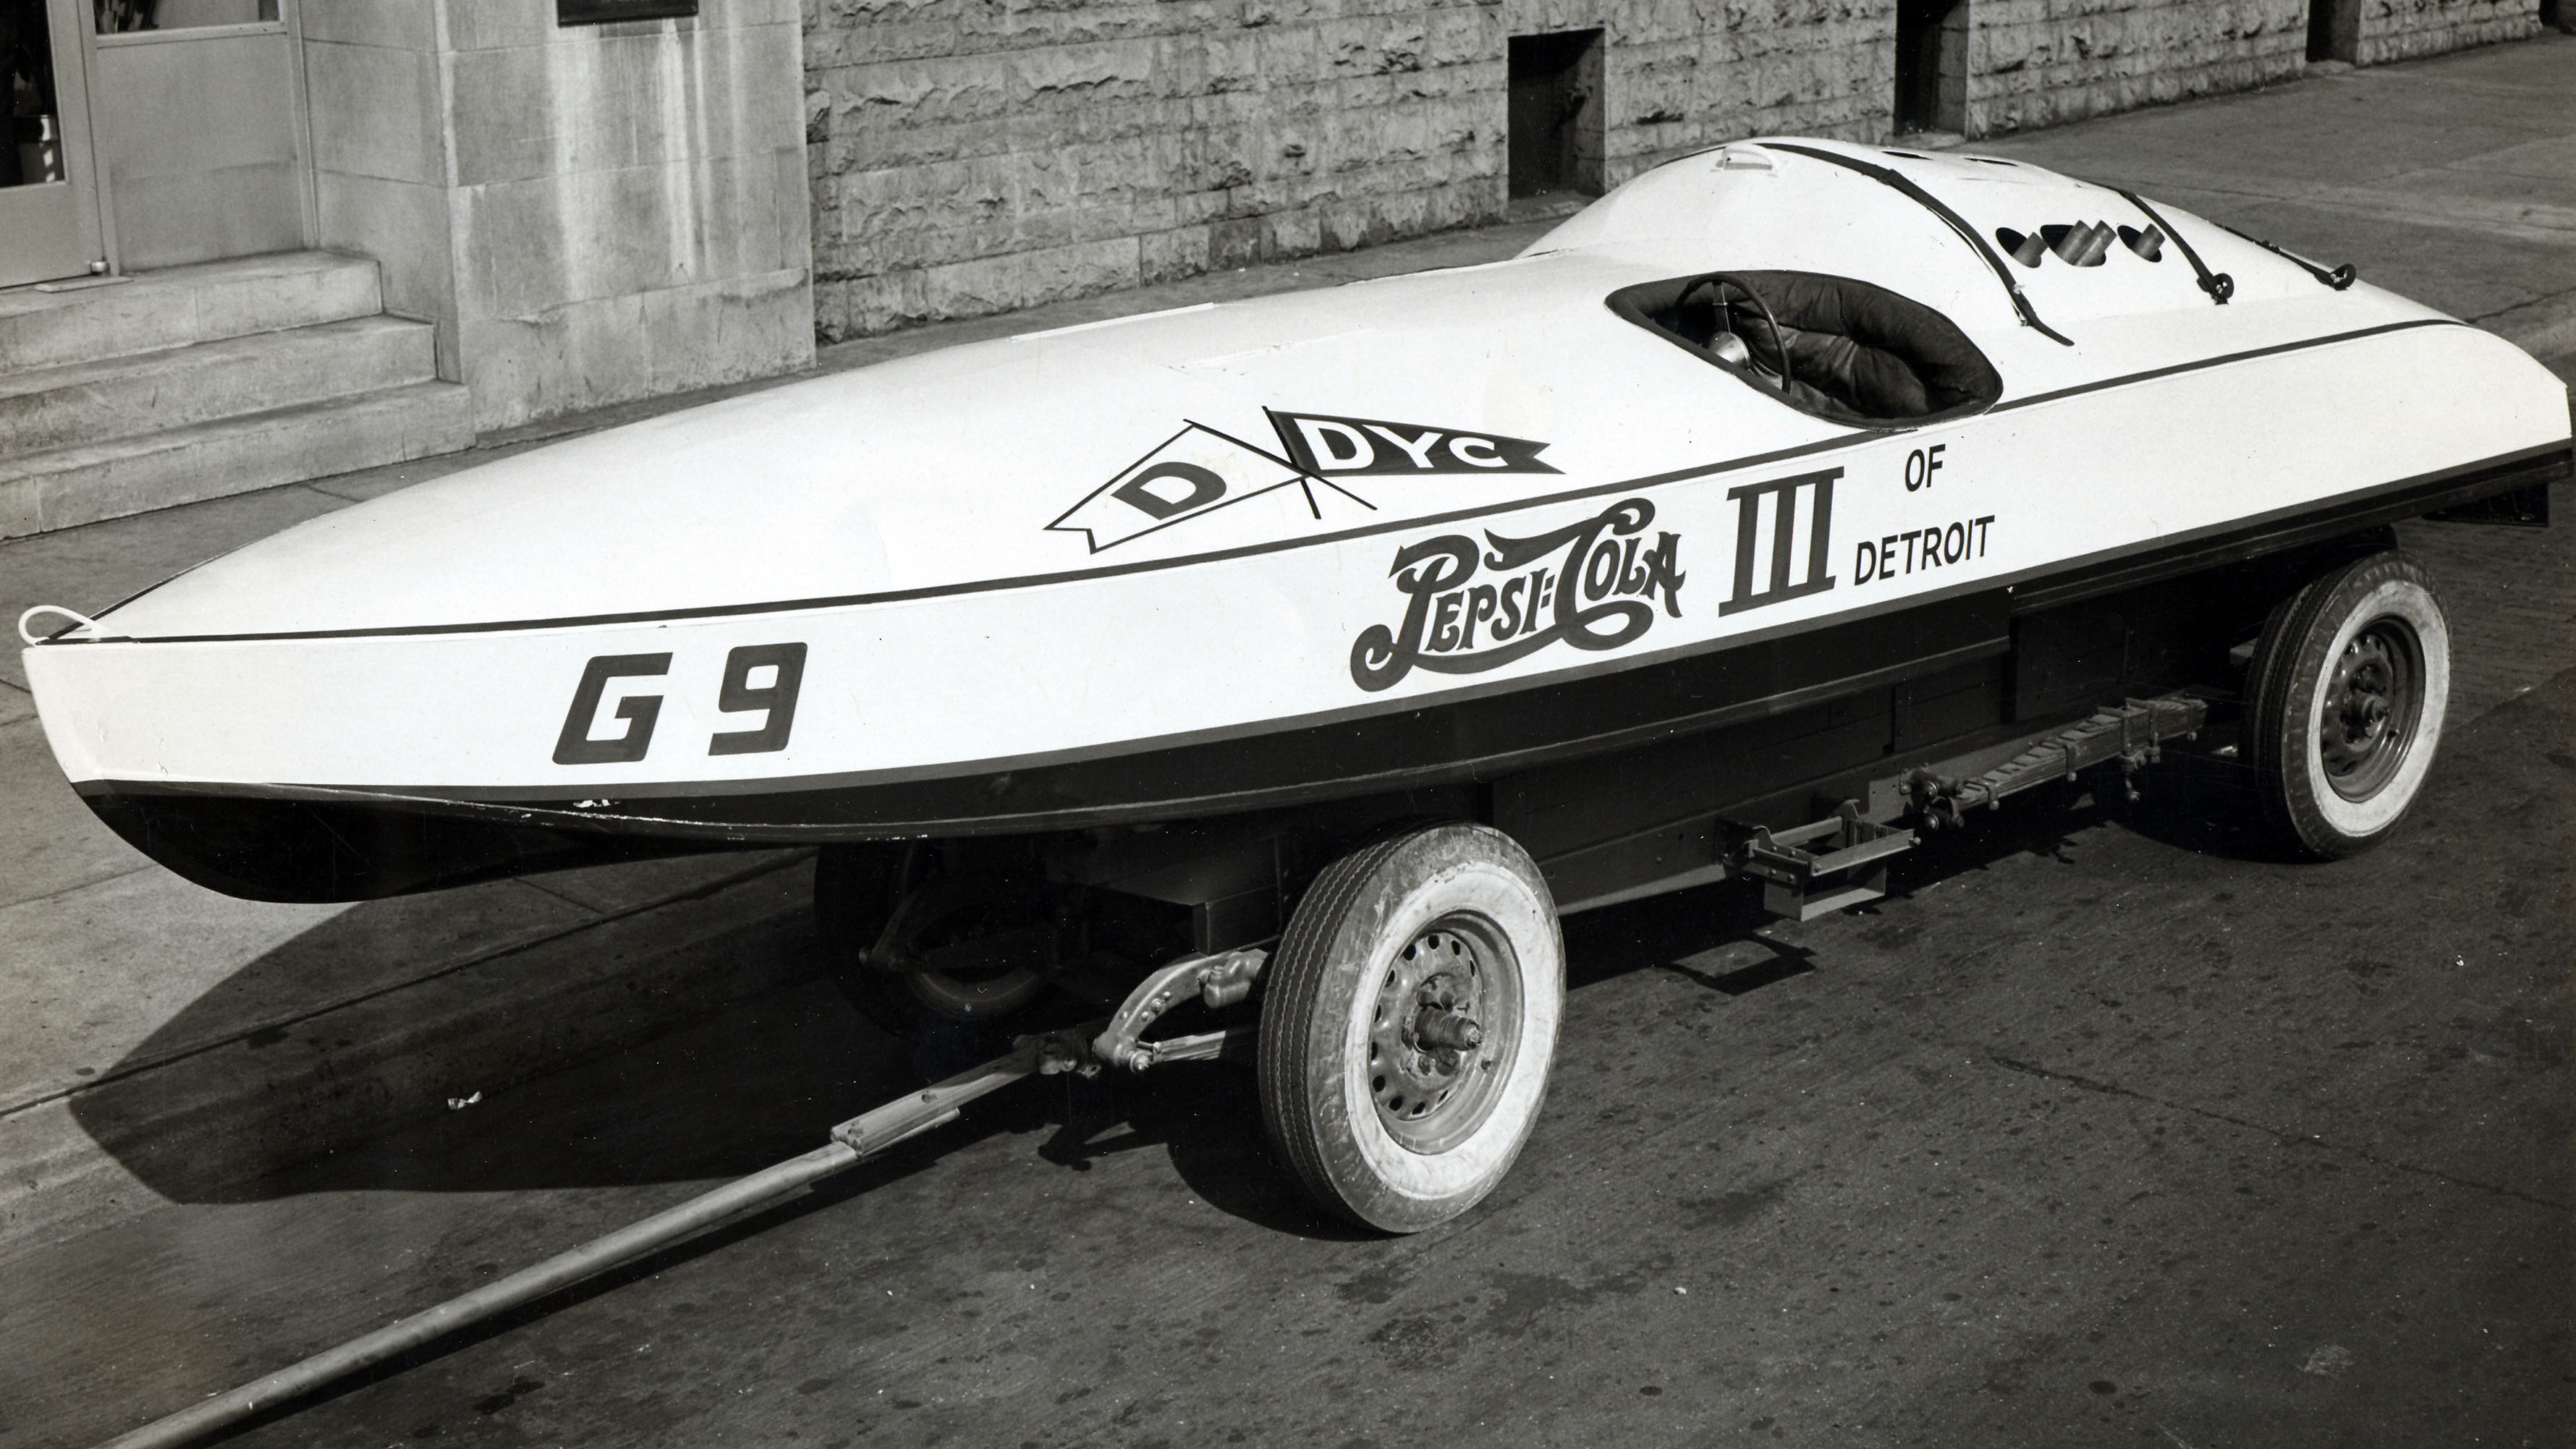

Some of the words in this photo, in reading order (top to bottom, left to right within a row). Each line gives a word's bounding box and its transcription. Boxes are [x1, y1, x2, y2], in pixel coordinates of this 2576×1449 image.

[1294, 418, 1509, 470] DYC
[1905, 443, 1946, 493] OF
[1110, 462, 1227, 520] D
[1718, 466, 1844, 618] III
[1854, 514, 1996, 586] DETROIT
